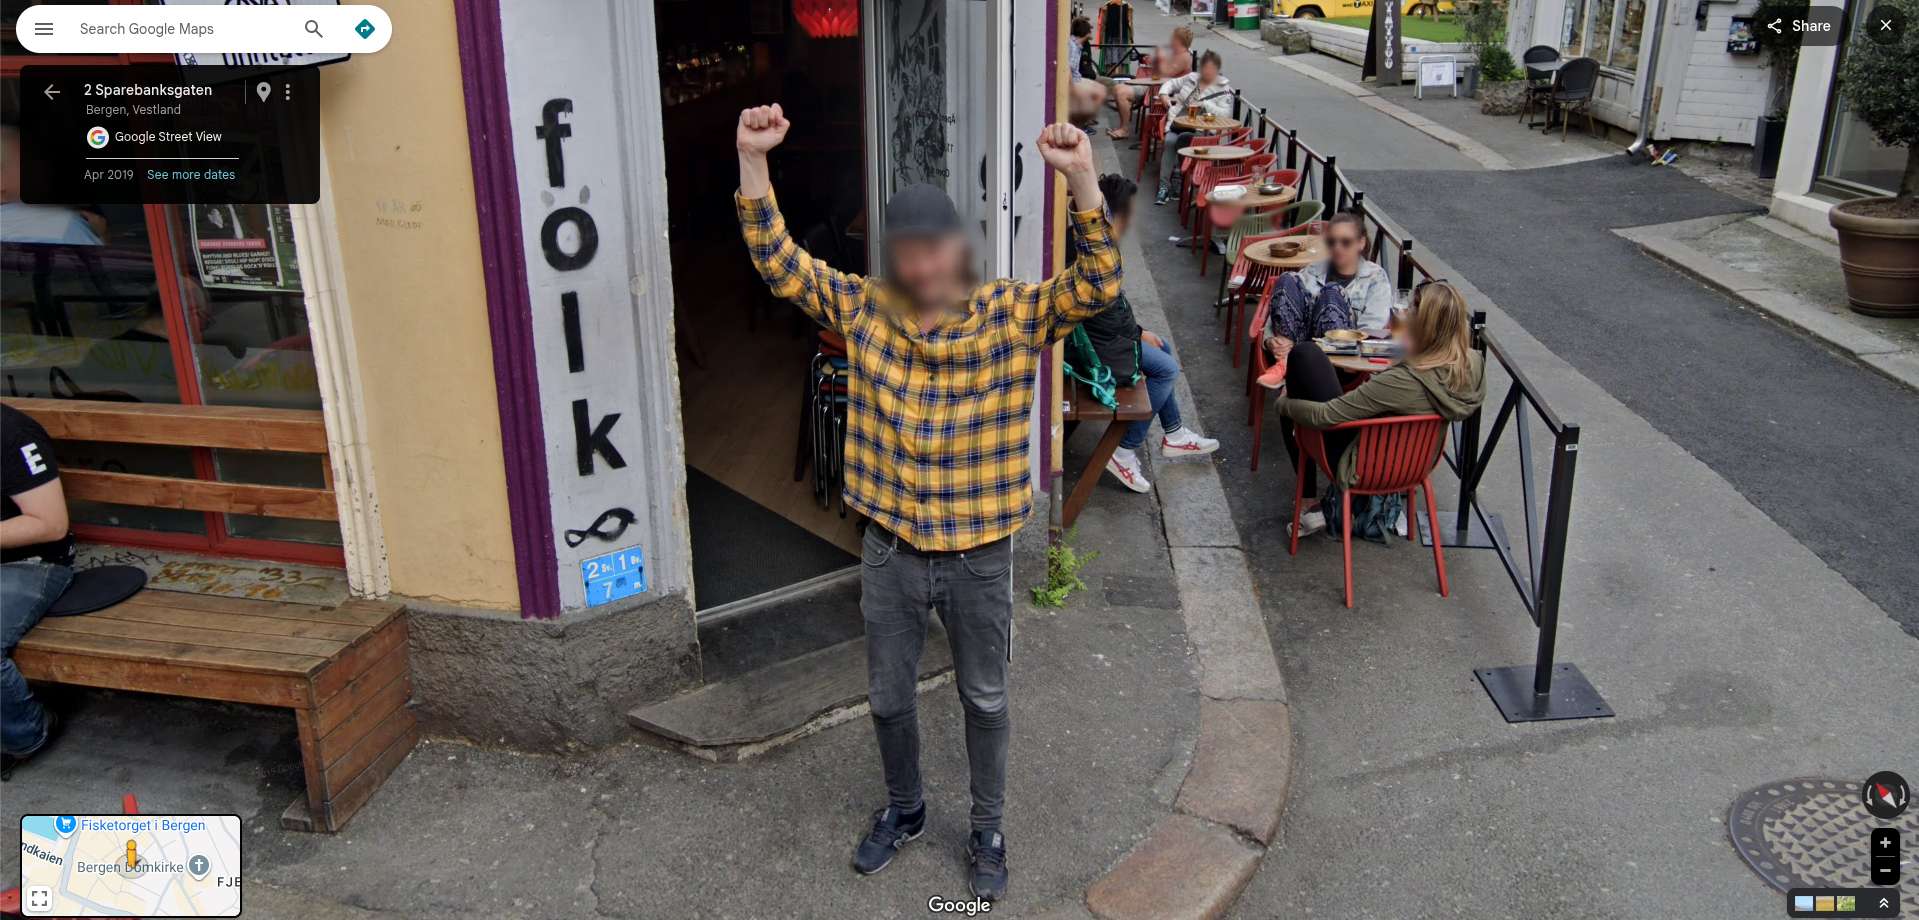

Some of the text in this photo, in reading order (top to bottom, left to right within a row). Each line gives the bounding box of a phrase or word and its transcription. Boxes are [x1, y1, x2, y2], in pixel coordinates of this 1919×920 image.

[20, 442, 47, 475] E
[588, 562, 600, 579] 2
[618, 553, 626, 570] 1
